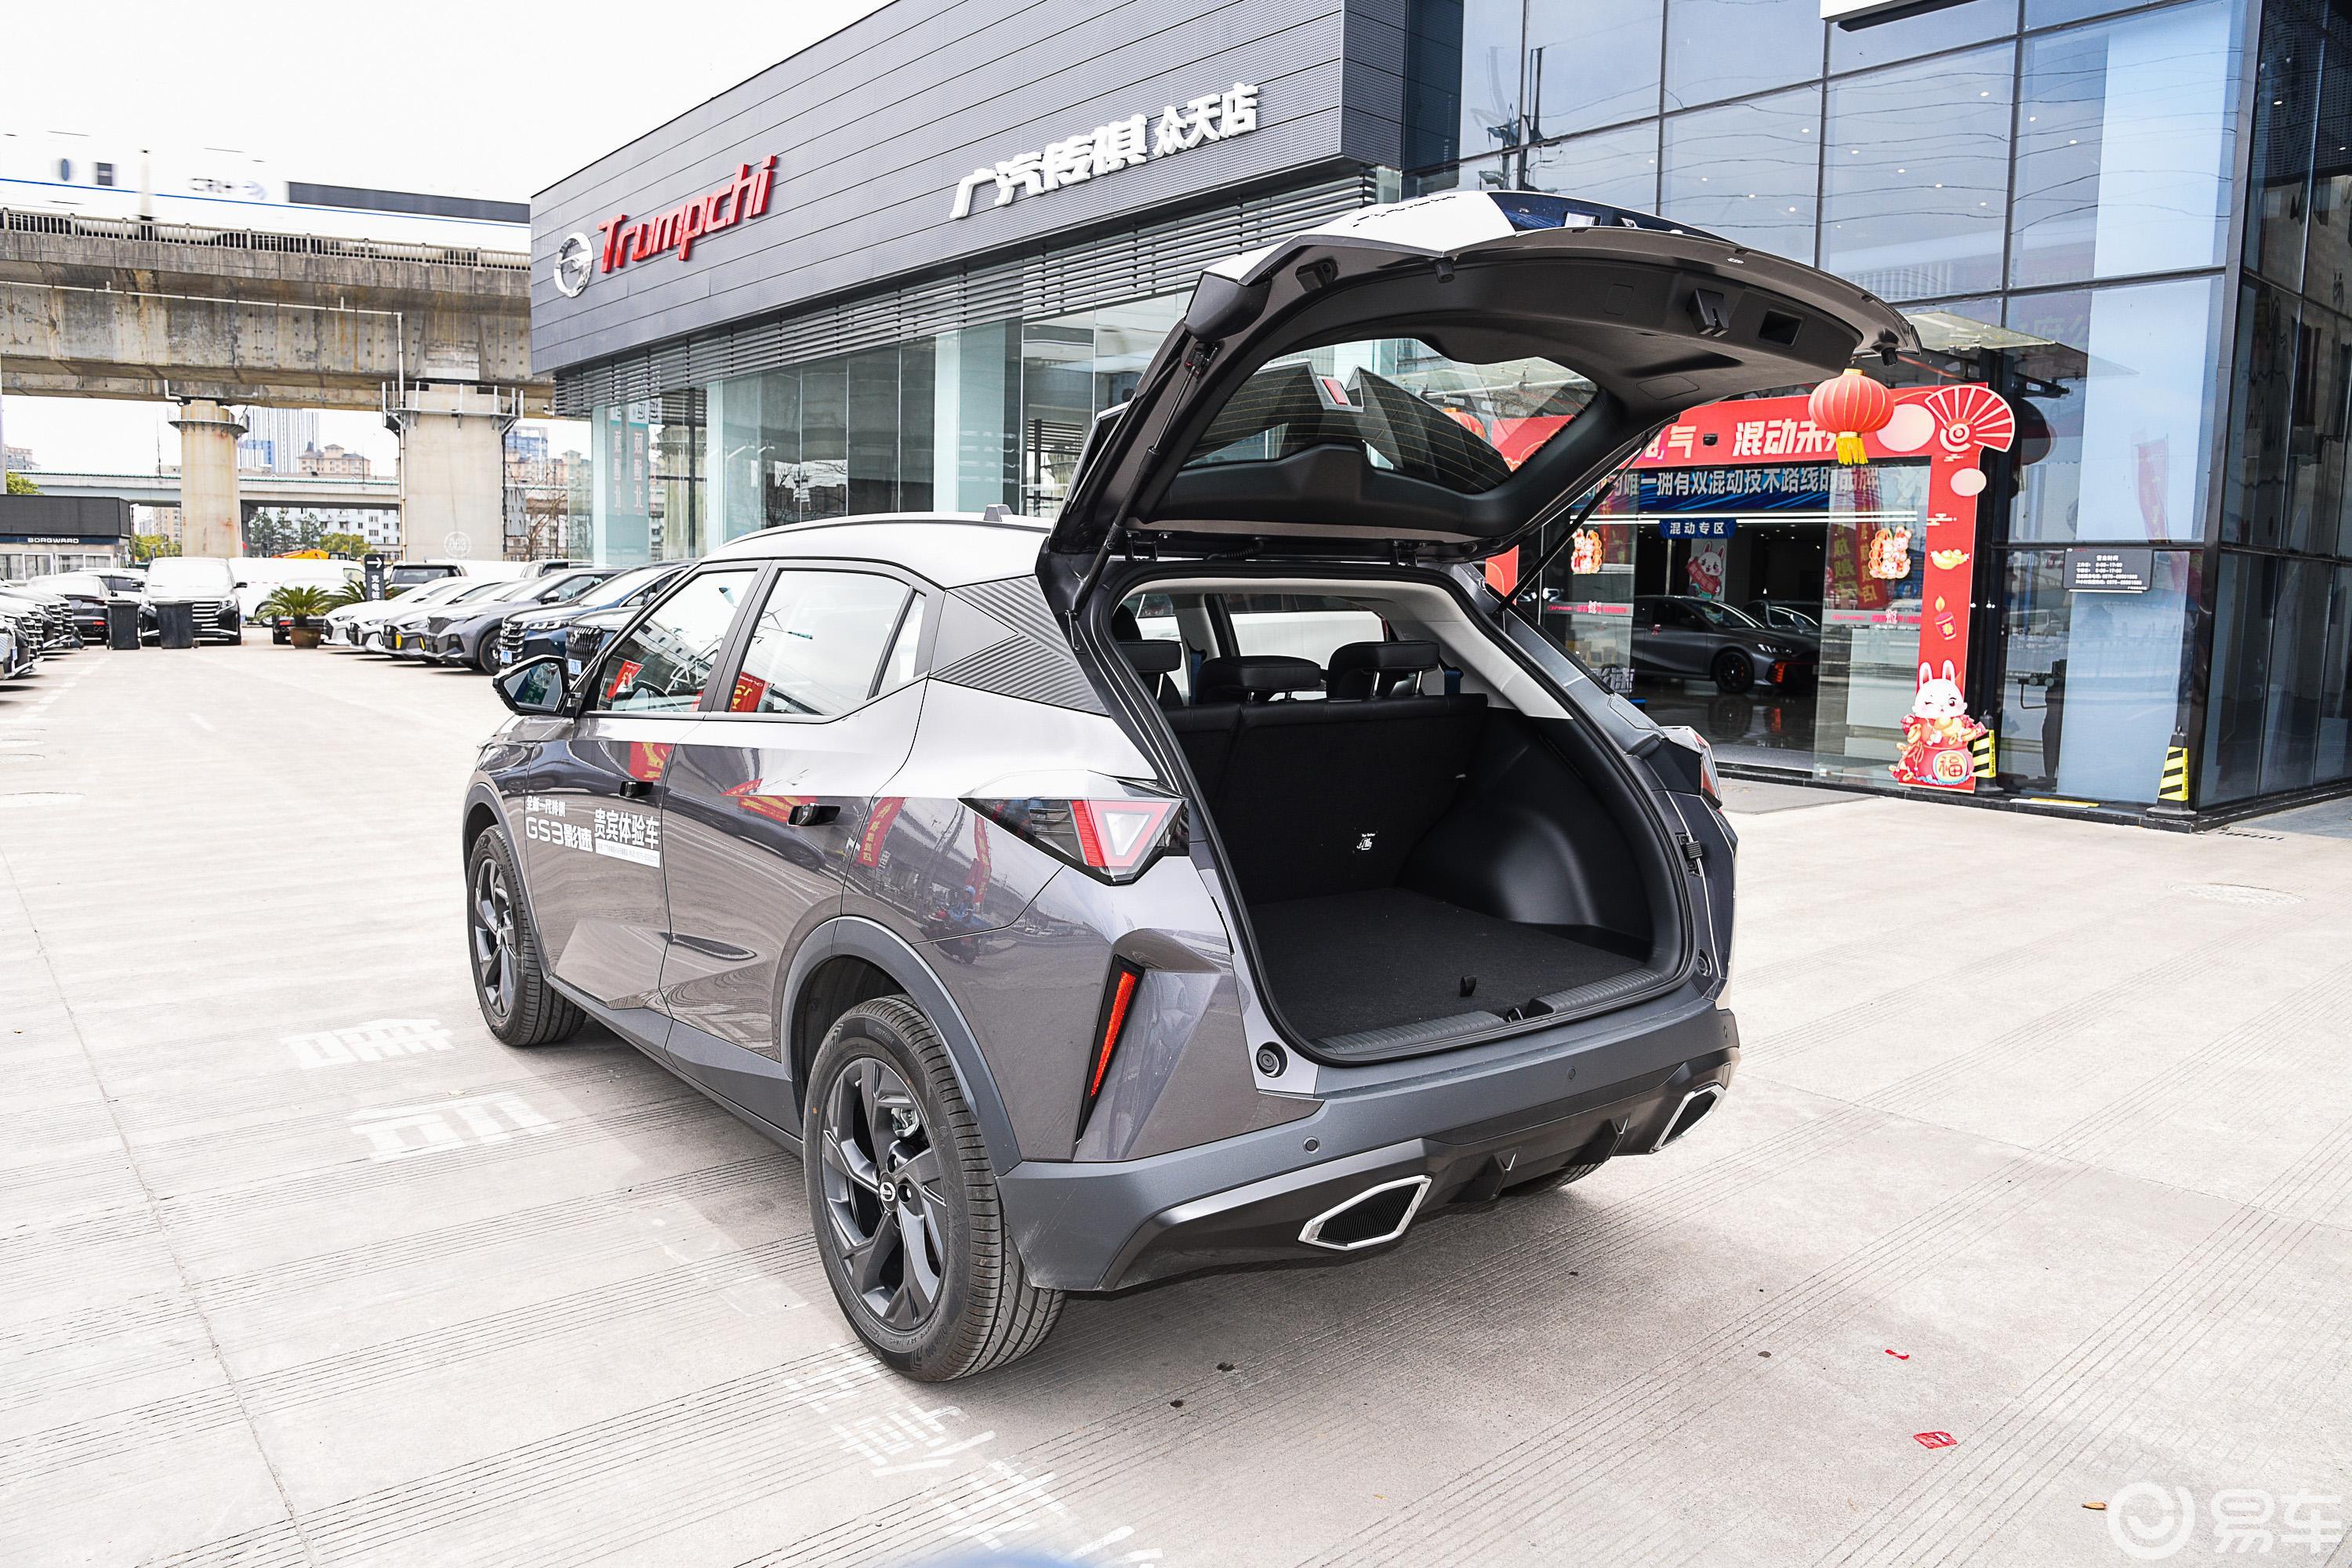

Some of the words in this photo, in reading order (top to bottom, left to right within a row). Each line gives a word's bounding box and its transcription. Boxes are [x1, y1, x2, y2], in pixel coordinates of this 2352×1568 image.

[949, 113, 1148, 220] 广汽传祺
[1152, 82, 1258, 158] 众天店
[597, 154, 777, 274] Trumpchi
[1670, 522, 1725, 535] 混动专区
[1938, 755, 1963, 777] 福
[525, 816, 593, 853] GS3影速
[593, 808, 660, 850] 贵宾体验车
